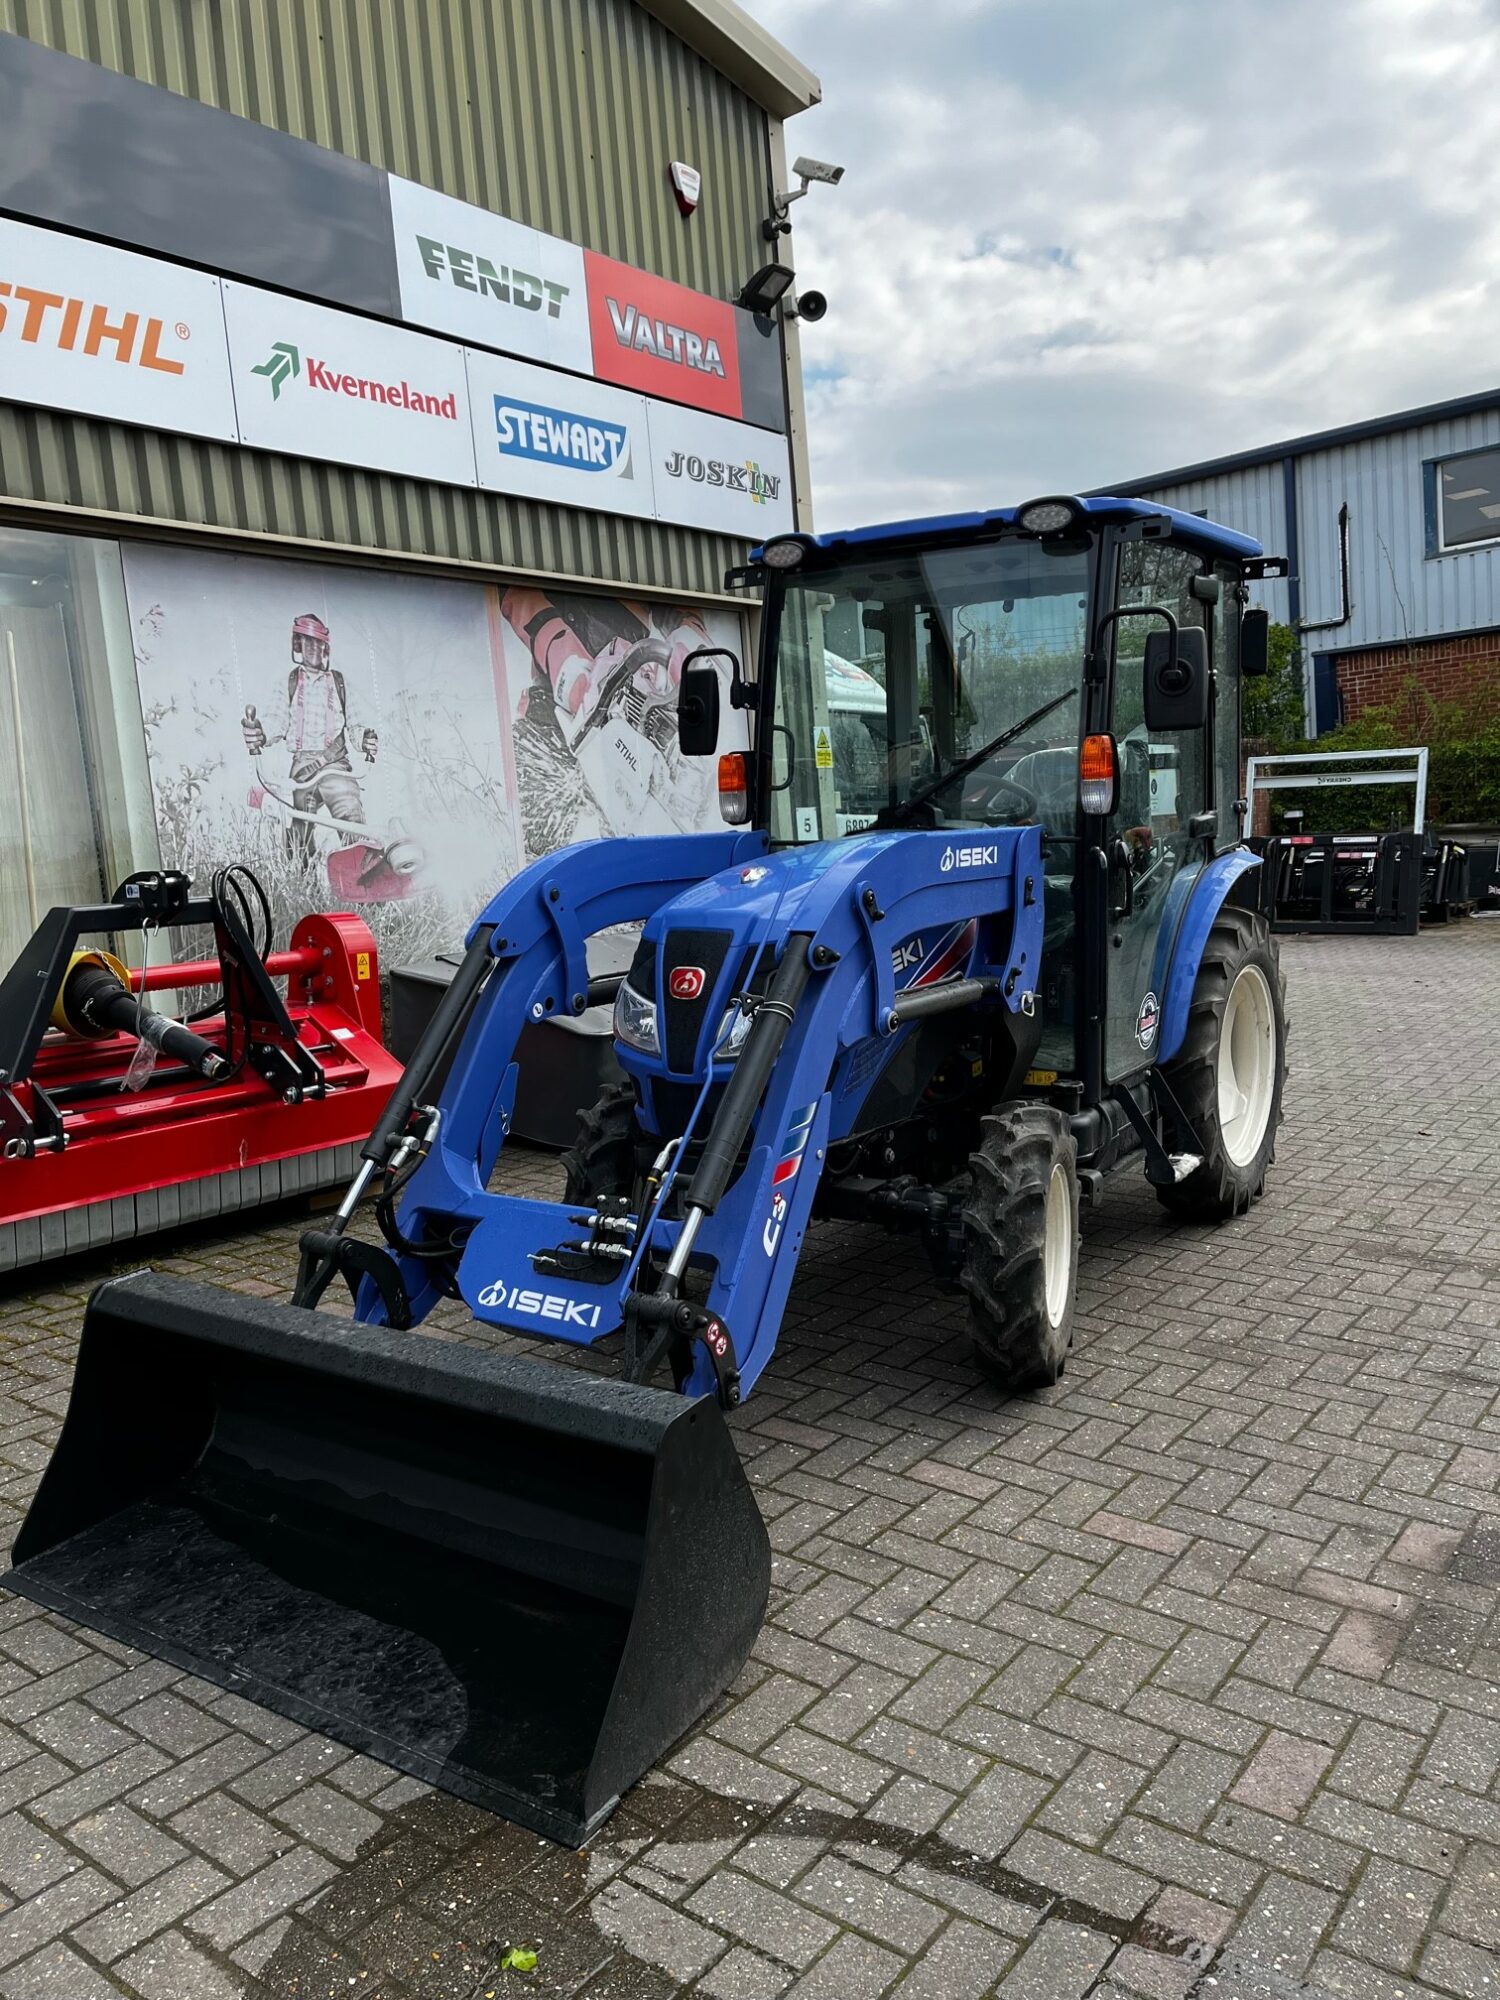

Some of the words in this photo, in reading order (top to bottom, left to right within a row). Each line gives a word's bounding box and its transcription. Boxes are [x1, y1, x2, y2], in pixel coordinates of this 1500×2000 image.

[415, 234, 570, 319] FENDT
[605, 296, 727, 379] VALTRA
[306, 357, 457, 420] Kverneland
[498, 406, 621, 468] STEWART
[665, 451, 780, 500] JOSKIN
[615, 738, 638, 772] STIHL
[804, 818, 811, 833] 5
[956, 846, 998, 868] ISEKI
[892, 938, 924, 974] EKI
[507, 1287, 601, 1328] ISEKI
